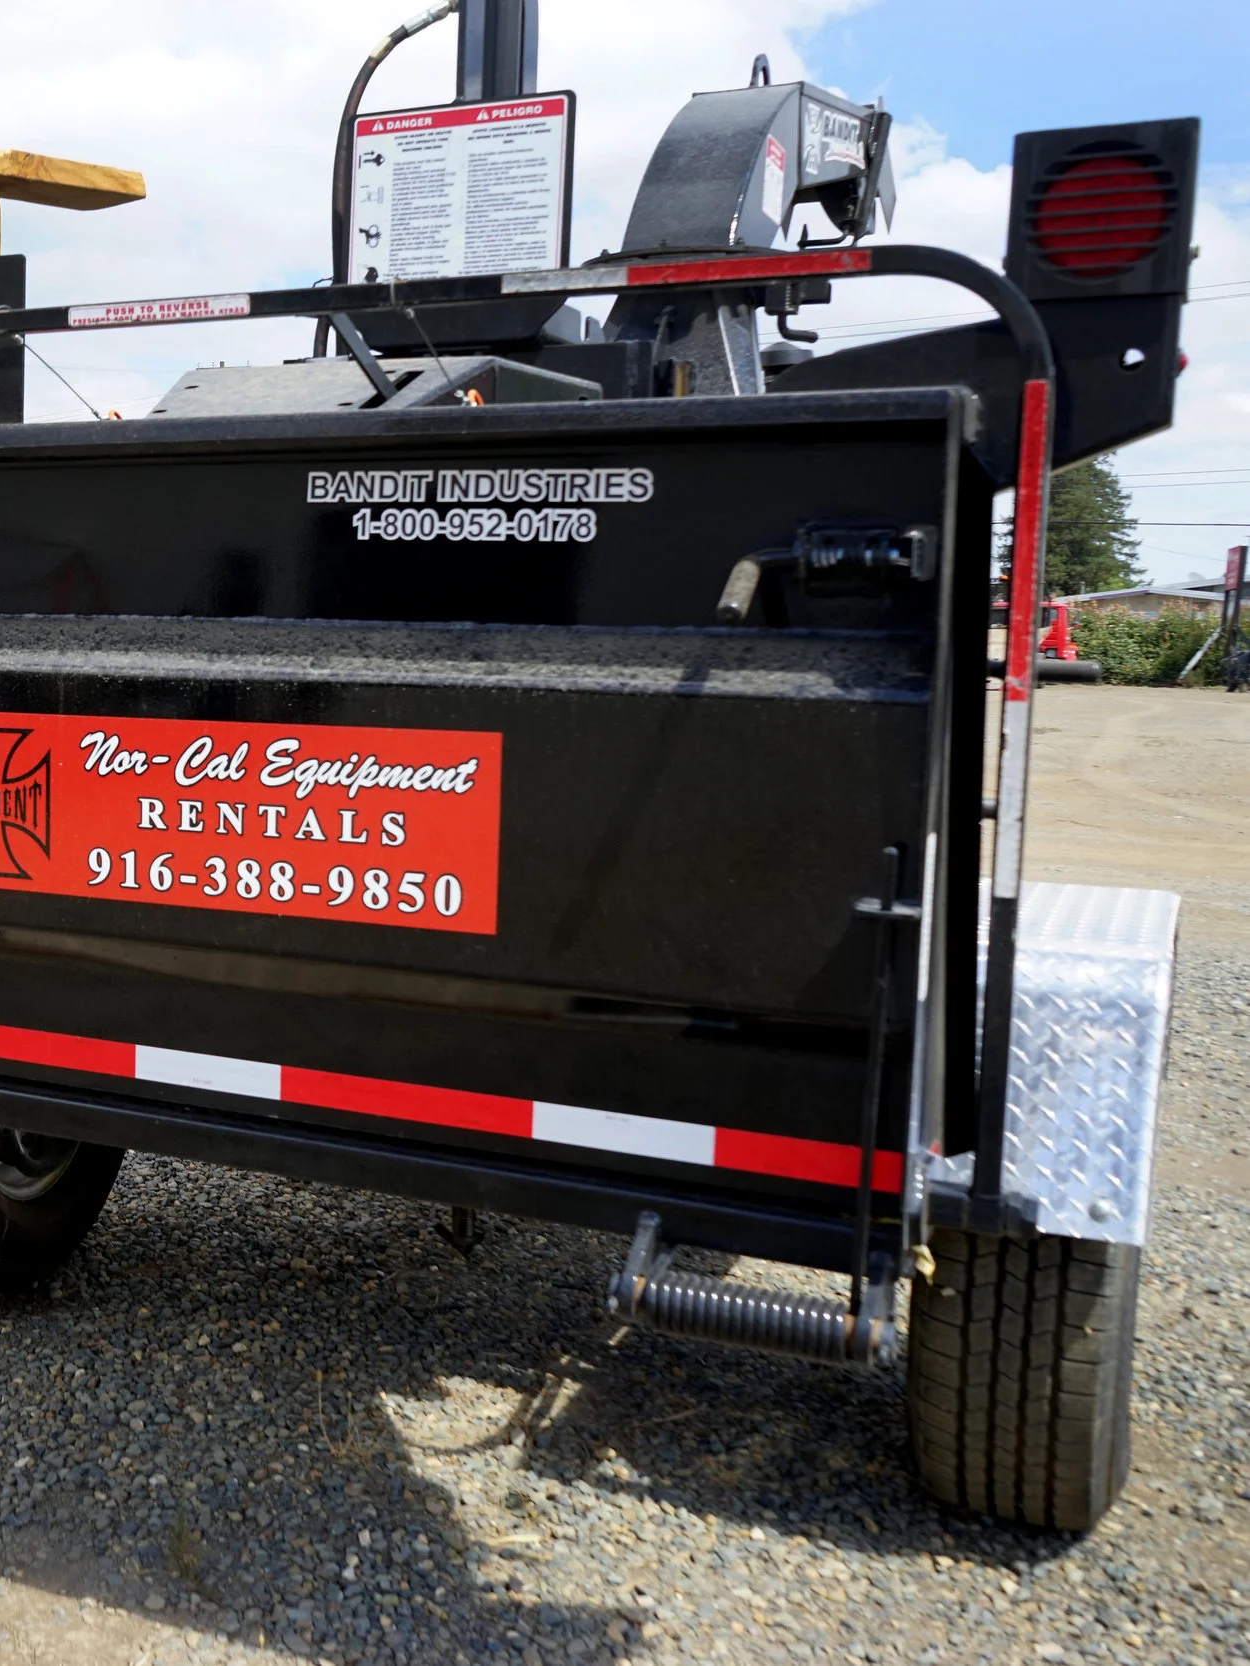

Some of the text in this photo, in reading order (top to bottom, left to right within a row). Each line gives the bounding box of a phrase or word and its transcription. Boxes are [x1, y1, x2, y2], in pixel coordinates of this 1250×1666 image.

[386, 117, 433, 130] DANGER
[491, 104, 543, 119] PELIGRO
[106, 301, 209, 316] PUSH TO REVERSE
[180, 309, 214, 318] MARCHA
[308, 468, 653, 503] BANDIT INDUSTRIES
[352, 508, 597, 542] 1-800-952-0178
[80, 730, 480, 799] Nor-Cal Equipment
[138, 797, 408, 847] RENTALS
[87, 847, 462, 917] 916-388-9850
